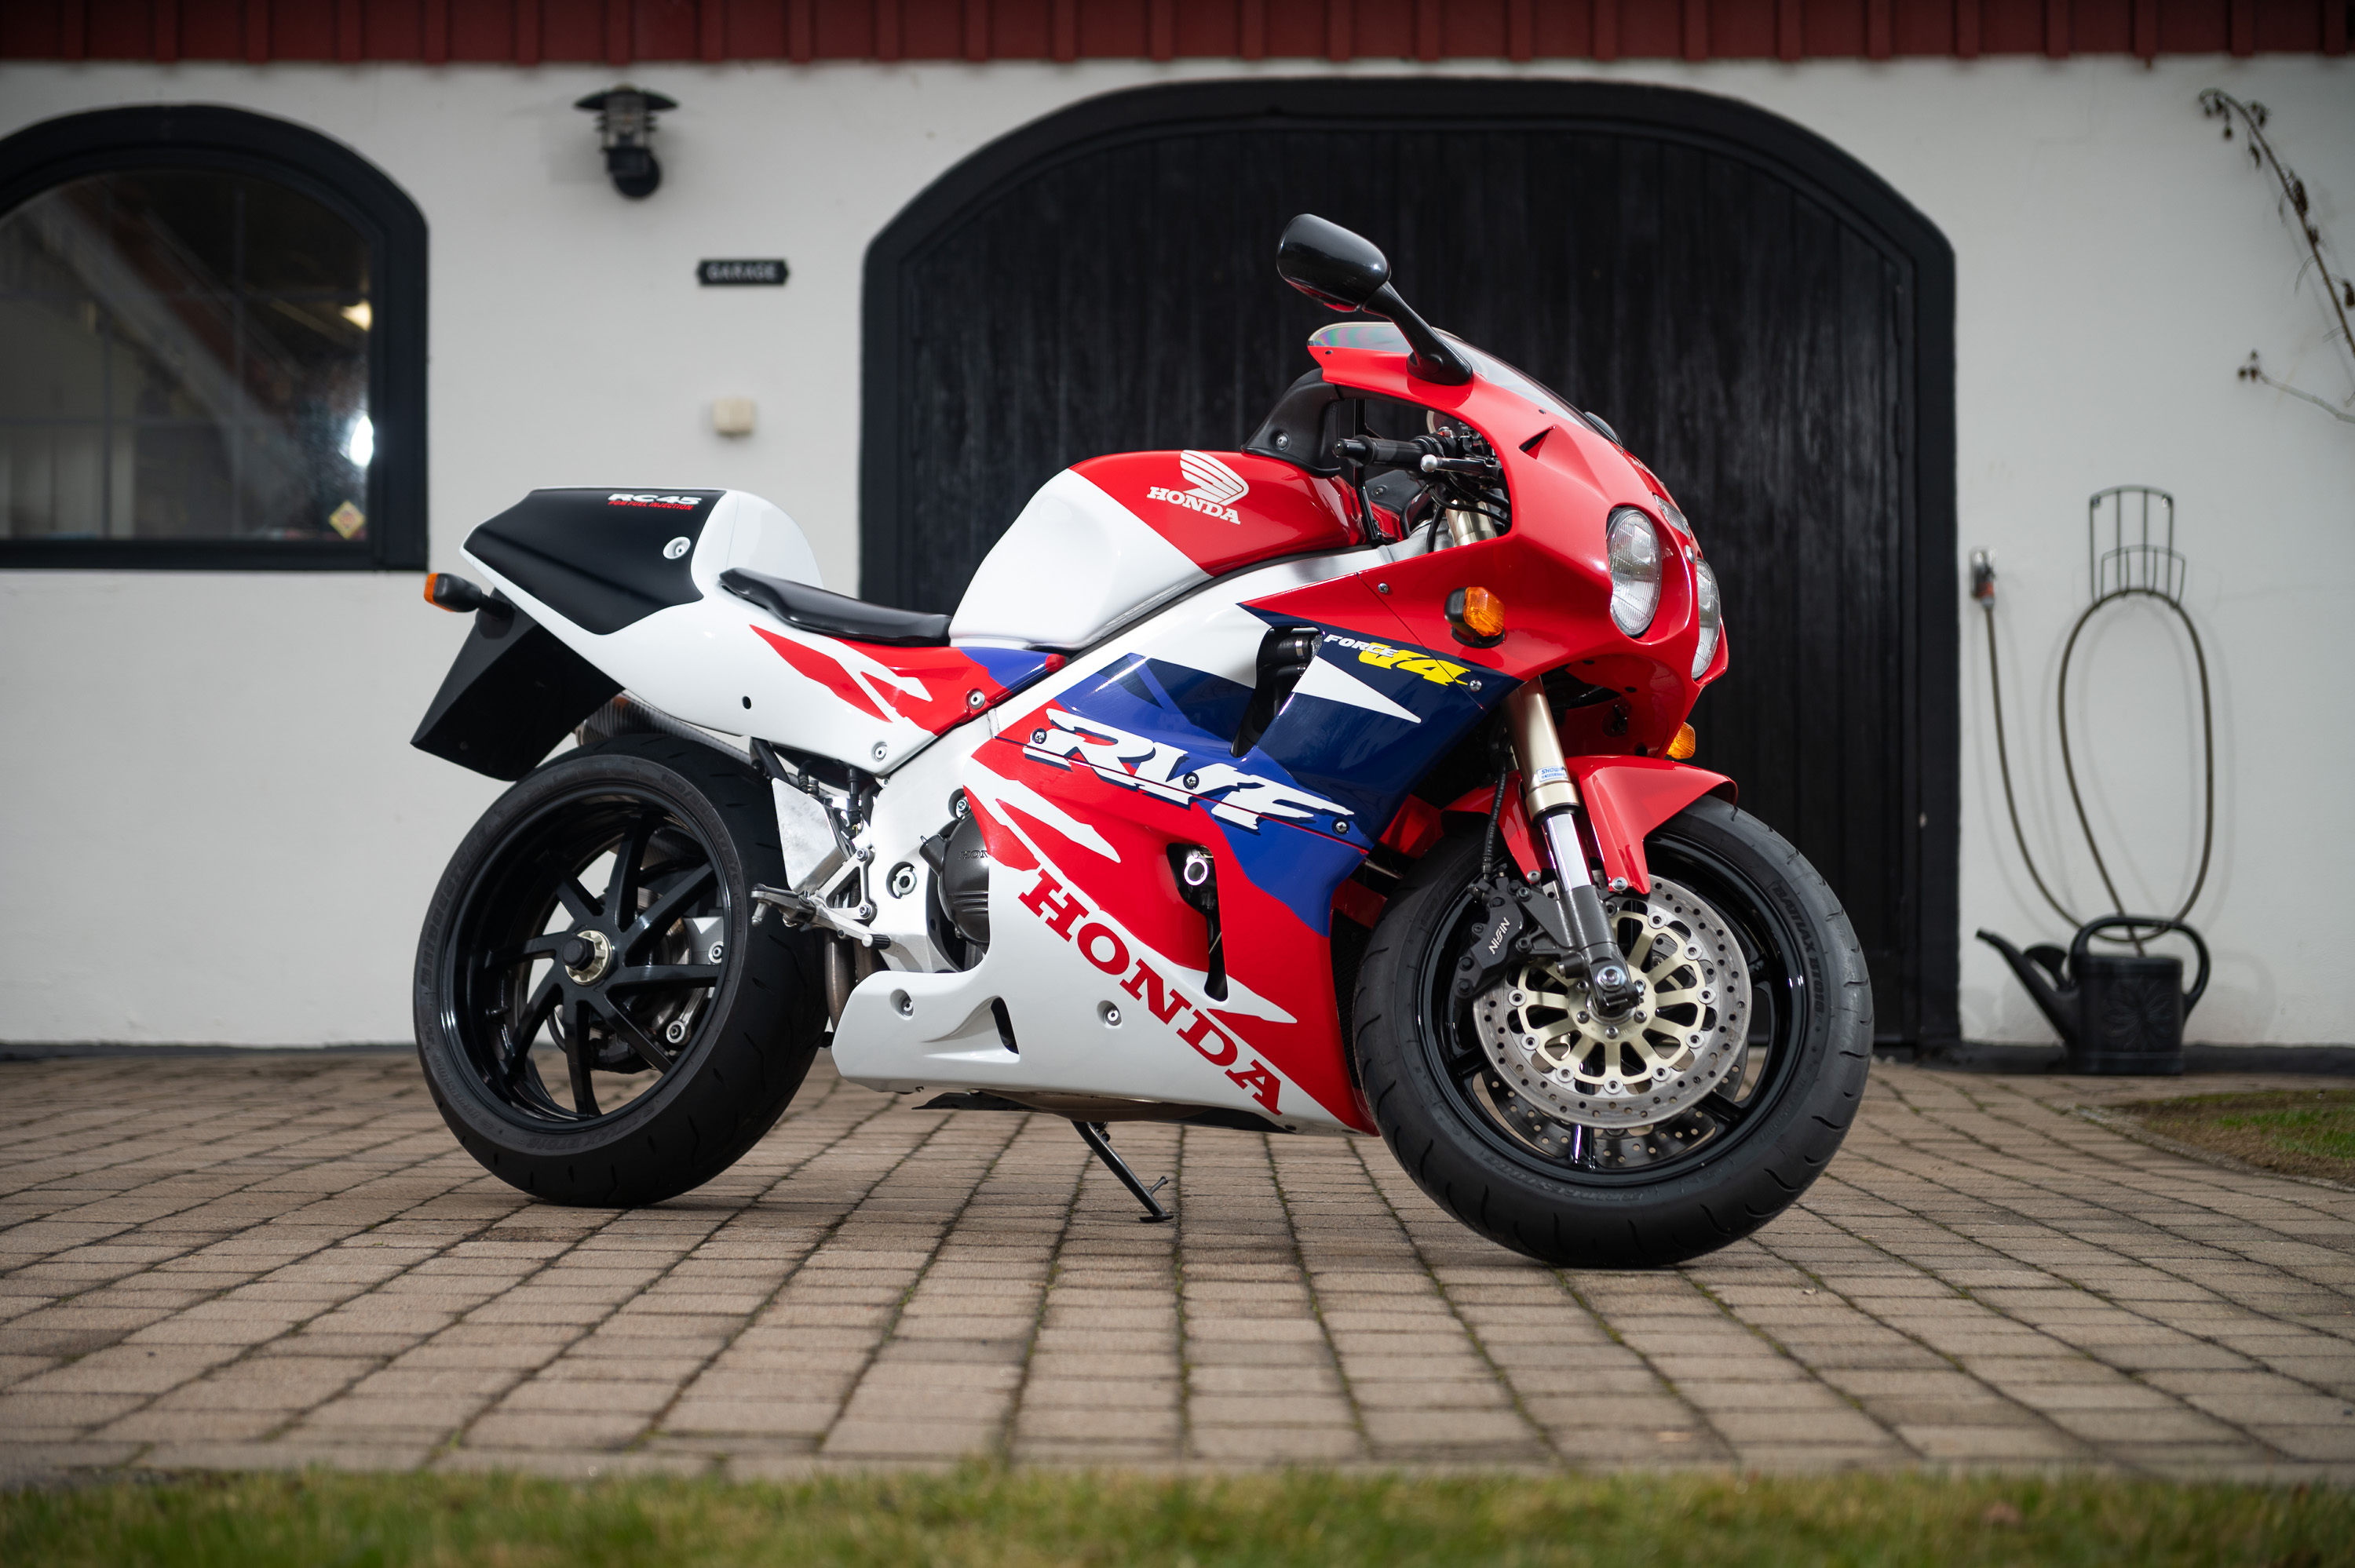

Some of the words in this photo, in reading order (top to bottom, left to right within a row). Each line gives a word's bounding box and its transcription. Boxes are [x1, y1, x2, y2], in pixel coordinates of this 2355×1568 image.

[608, 493, 703, 505] RC45
[1147, 486, 1241, 525] HONDA
[1324, 634, 1399, 658] FORCE
[1359, 642, 1471, 686] V4
[1022, 708, 1355, 830] RVF
[1488, 917, 1510, 955] NISSIN
[1018, 868, 1283, 1116] HONDA
